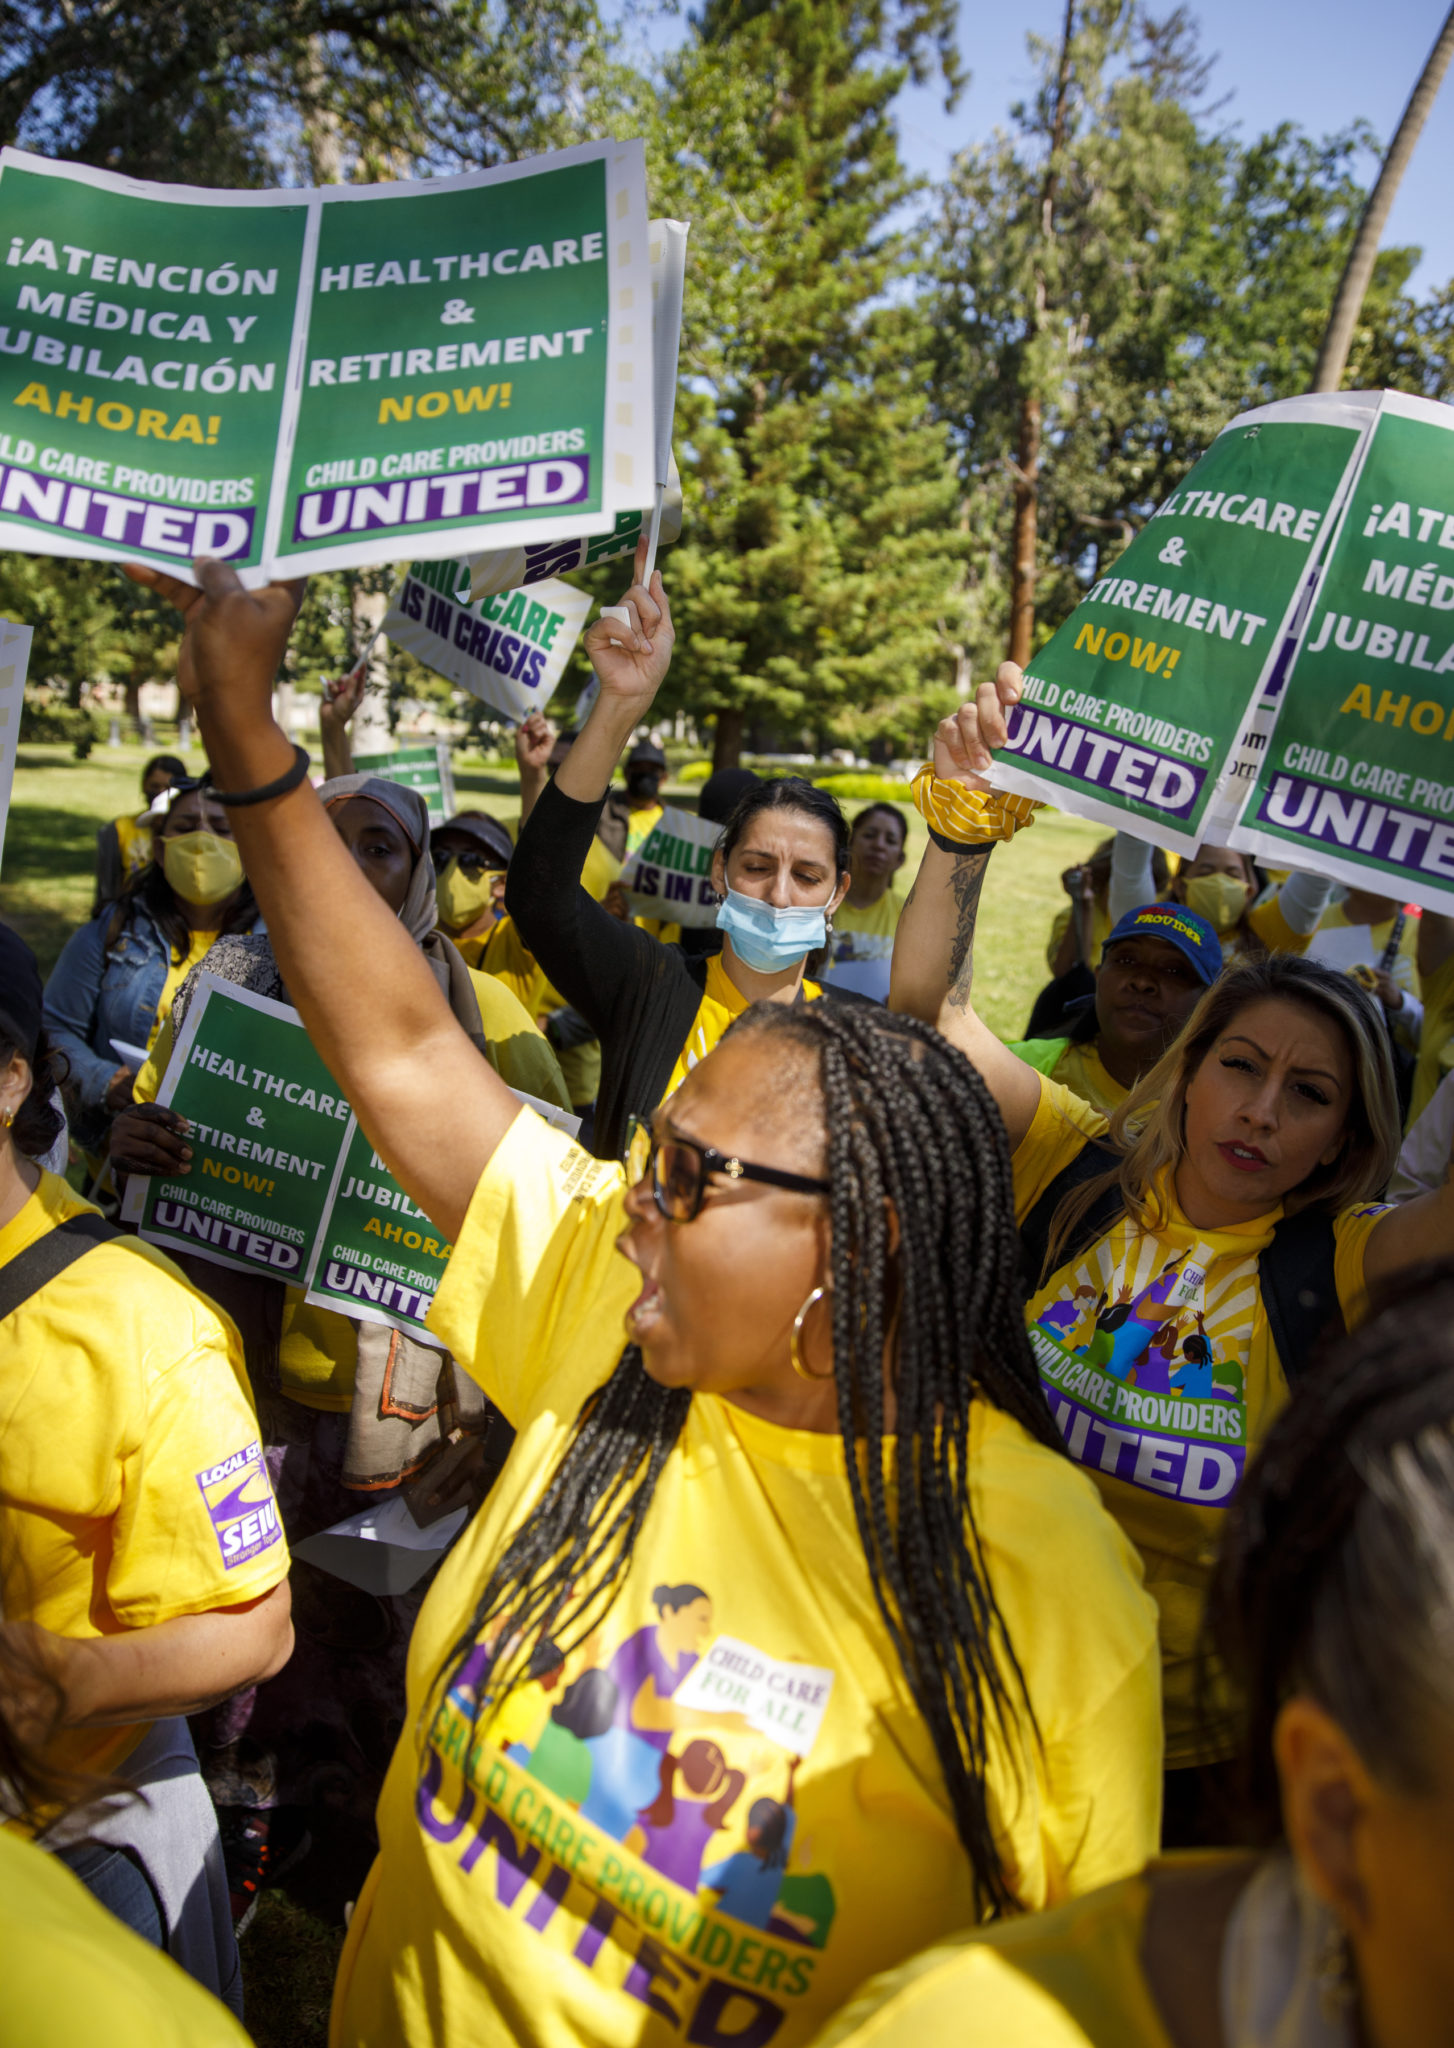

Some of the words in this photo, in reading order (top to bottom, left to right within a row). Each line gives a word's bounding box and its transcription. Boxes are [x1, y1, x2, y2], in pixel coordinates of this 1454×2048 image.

[7, 238, 278, 296] ¡ATENCIÓN
[319, 232, 603, 292] HEALTHCARE
[17, 286, 212, 344] MÉDICA
[227, 316, 258, 344] Y
[440, 299, 476, 325] &
[0, 326, 275, 393] UBILACIÓN
[309, 328, 593, 387] RETIREMENT
[14, 382, 222, 445] AHORA!
[377, 382, 513, 424] NOW!
[39, 447, 111, 487] CARE
[113, 464, 255, 504] PROVIDERS
[305, 457, 376, 488] CHILD
[381, 446, 444, 478] CARE
[448, 427, 585, 468] PROVIDERS
[0, 465, 250, 559] NITED
[299, 458, 585, 540] UNITED
[1158, 536, 1188, 567] &
[1081, 578, 1267, 646] TIREMENT
[1362, 559, 1454, 611] MÉD
[400, 578, 425, 622] IS
[425, 594, 453, 640] IN
[454, 612, 547, 688] CRISIS
[480, 590, 565, 651] CARE
[1307, 611, 1454, 675] JUBILA
[1073, 623, 1181, 679] NOW!
[1021, 674, 1061, 707] HILD
[1060, 689, 1107, 723] CARE
[1103, 703, 1214, 763] PROVIDERS
[1339, 683, 1454, 742] AHO
[1004, 705, 1196, 809] UNITED
[1283, 742, 1349, 782] CHILD
[1350, 761, 1410, 800] CARE
[1267, 777, 1454, 878] UNITE
[633, 864, 660, 896] IS
[664, 873, 693, 903] IN
[190, 1044, 350, 1121] HEALTHCARE
[246, 1106, 267, 1130] &
[167, 1119, 326, 1181] ETIREMENT
[201, 1157, 276, 1197] NOW!
[155, 1201, 299, 1270] UNITED
[160, 1183, 199, 1206] CHILD
[200, 1196, 234, 1220] CARE
[235, 1208, 305, 1244] PROVIDERS
[363, 1217, 454, 1260] AHORA
[326, 1262, 434, 1321] UNITE
[332, 1244, 372, 1267] CHILD
[372, 1258, 407, 1280] CARE
[1062, 1363, 1114, 1411] CARE
[1112, 1386, 1242, 1439] PROVIDERS
[201, 1453, 245, 1487] LOCAL
[1043, 1390, 1237, 1501] ITED
[223, 1498, 275, 1557] SEIU
[701, 1671, 750, 1705] FOR
[761, 1700, 806, 1733] ALL
[709, 1647, 765, 1680] CHILD
[767, 1672, 825, 1706] CARE
[416, 1745, 787, 2048] UNITED
[510, 1788, 597, 1869] CARE
[598, 1853, 816, 1997] PROVIDERS
